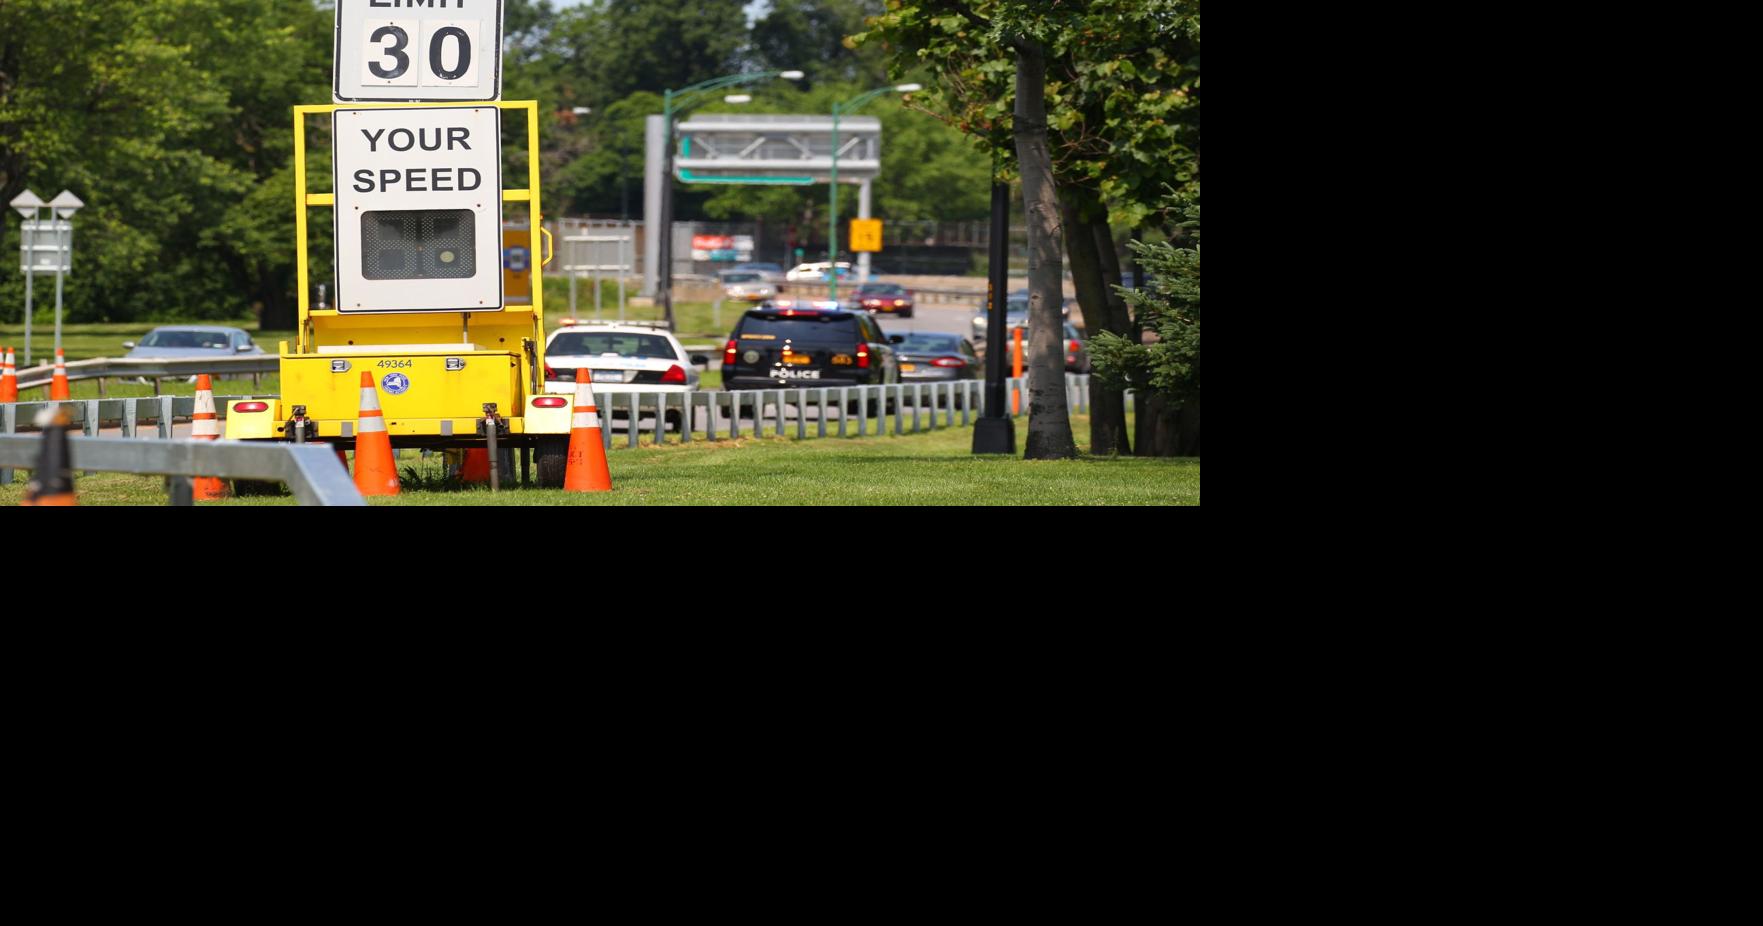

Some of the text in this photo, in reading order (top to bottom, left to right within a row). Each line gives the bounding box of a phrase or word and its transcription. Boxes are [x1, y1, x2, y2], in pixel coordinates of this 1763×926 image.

[368, 25, 472, 80] 30
[361, 127, 472, 152] YOUR
[353, 167, 482, 193] SPEED
[376, 359, 412, 369] 49364
[769, 369, 820, 379] POLICE
